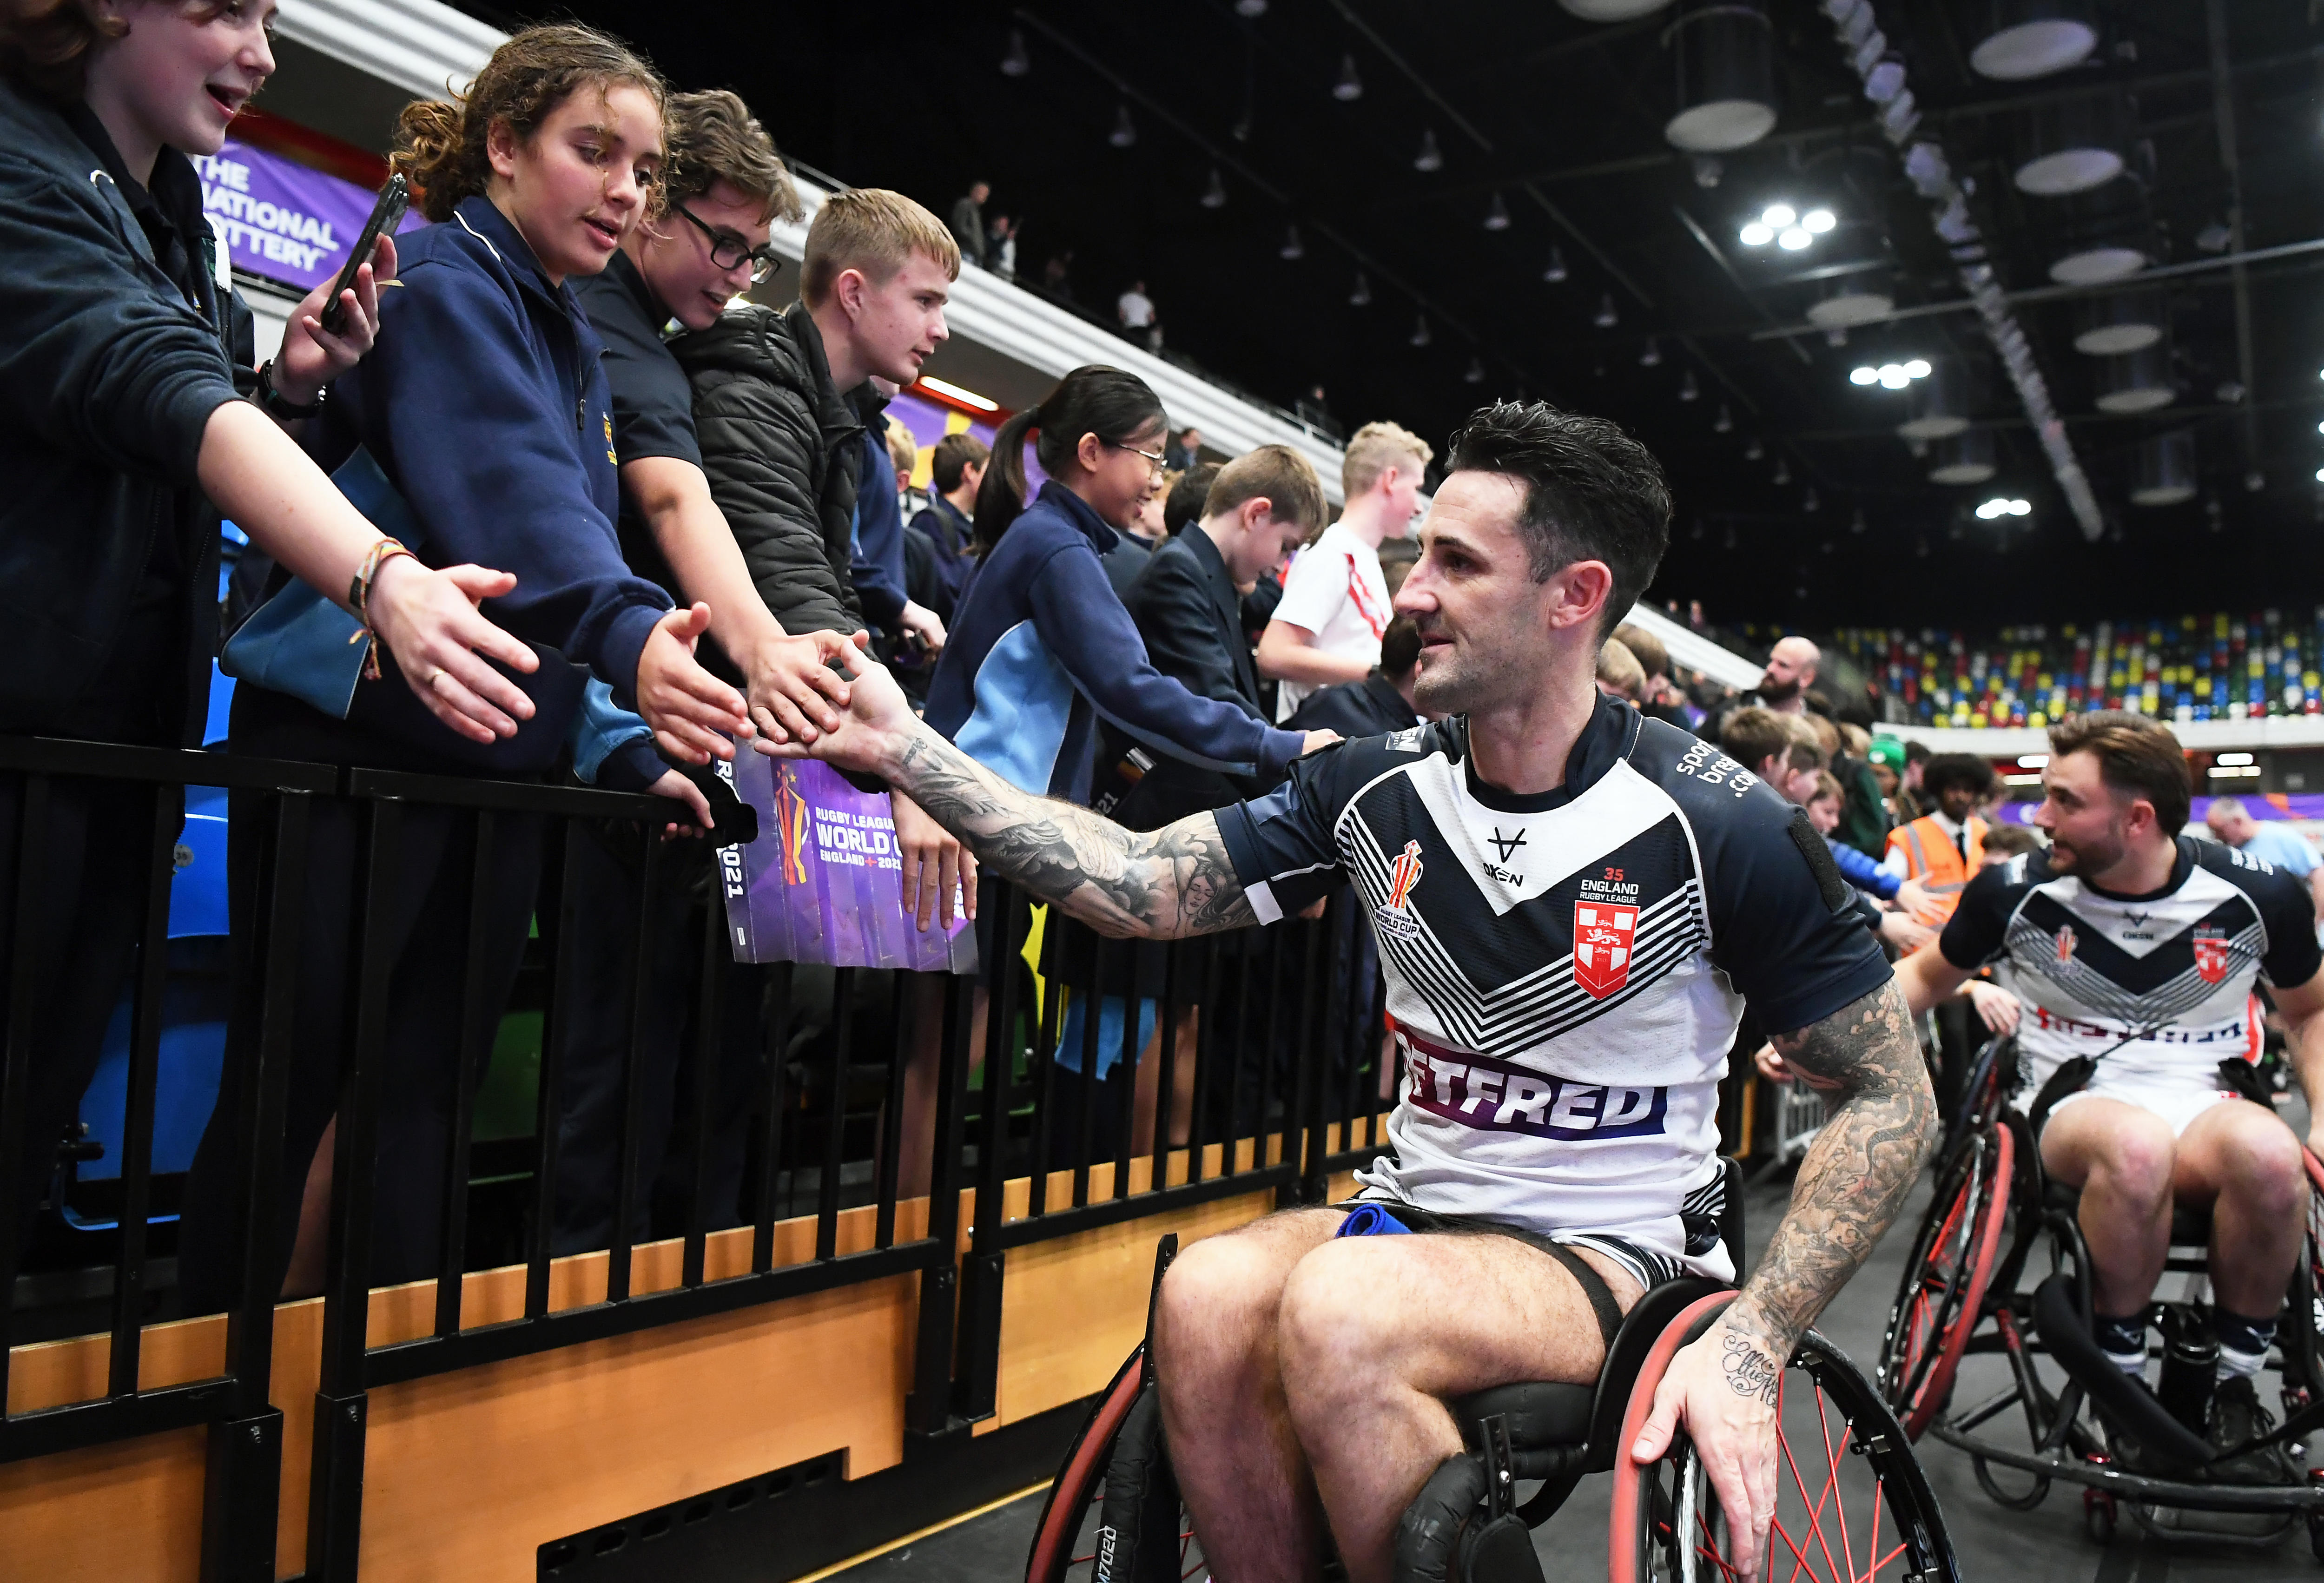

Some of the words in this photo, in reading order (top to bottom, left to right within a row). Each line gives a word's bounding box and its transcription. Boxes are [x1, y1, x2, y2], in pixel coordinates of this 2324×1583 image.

[193, 155, 251, 193] THE
[204, 212, 321, 271] TTERY
[1697, 754, 1743, 784] brea
[816, 806, 851, 824] RUGBY
[852, 813, 896, 831] LEAGU
[816, 822, 891, 854] WORLD
[820, 849, 865, 866] ENGLAND
[878, 857, 902, 871] 2021
[1483, 863, 1524, 887] OXEN
[1604, 867, 1624, 882] 35
[1579, 891, 1605, 901] RUGBY
[1606, 894, 1637, 904] LEAGUE
[1581, 879, 1639, 895] ENGLAND
[1376, 911, 1399, 929] WORLD
[1400, 923, 1417, 934] CUP
[1394, 914, 1411, 923] LEAGUE
